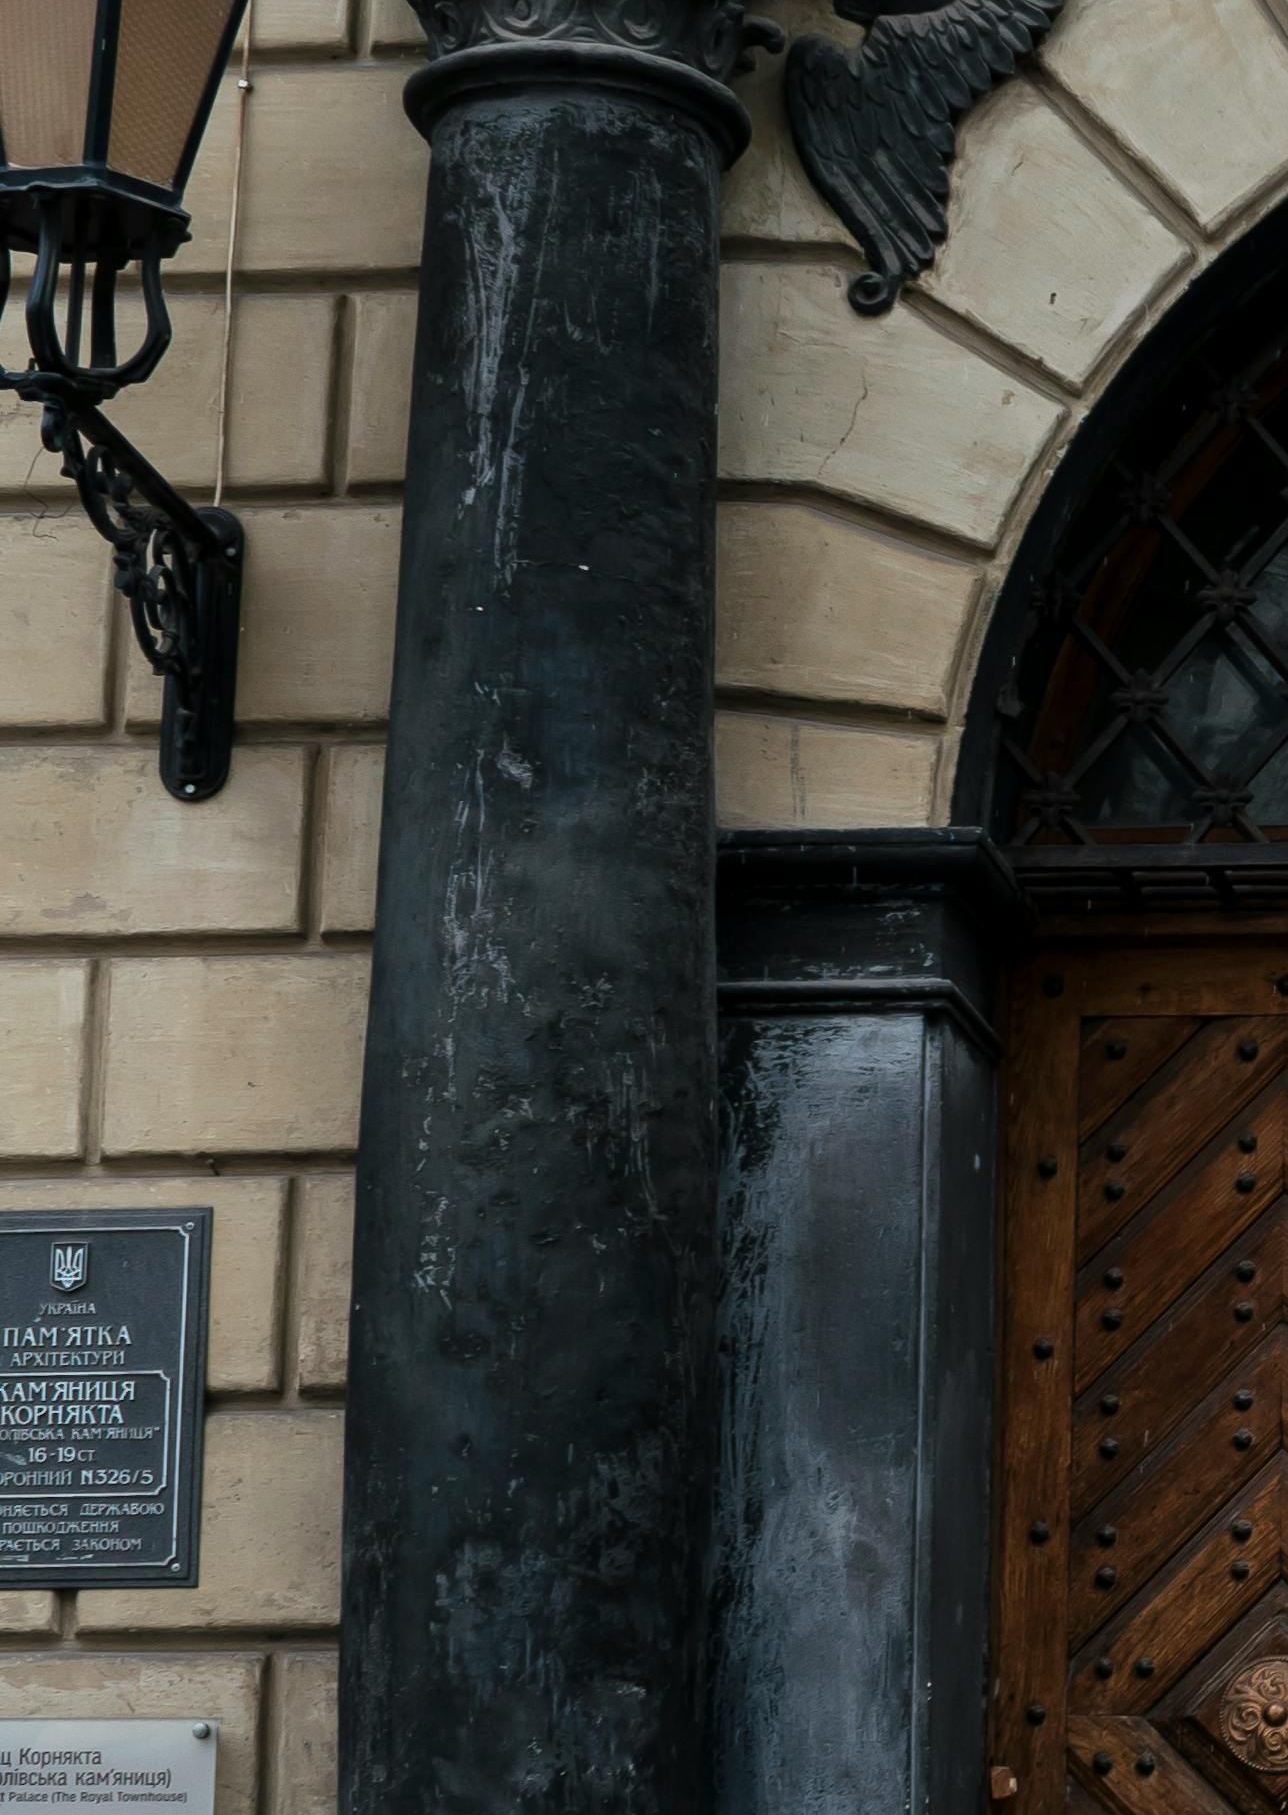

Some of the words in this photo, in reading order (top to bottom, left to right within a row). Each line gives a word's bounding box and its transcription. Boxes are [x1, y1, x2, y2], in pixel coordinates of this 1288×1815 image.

[39, 1300, 97, 1315] УКРАЇНА
[3, 1325, 133, 1347] ПАМ'ЯТКА
[10, 1350, 125, 1367] АРХІТЕКТУРИ
[0, 1404, 125, 1426] КОРНЯКТА
[0, 1503, 69, 1517] НЯЄТЬСЯ
[79, 1502, 165, 1517] ДЕРЖАВОЮ
[2, 1521, 120, 1535] ПОШКОДЖЕННЯ
[71, 1538, 142, 1552] ЗАКОНОМ
[19, 1747, 103, 1769] Корнякта
[0, 1768, 68, 1786] лівська
[8, 1791, 49, 1802] Palace
[51, 1791, 77, 1803] (The
[80, 1791, 114, 1804] Royal
[117, 1791, 188, 1804] Townhouse)
